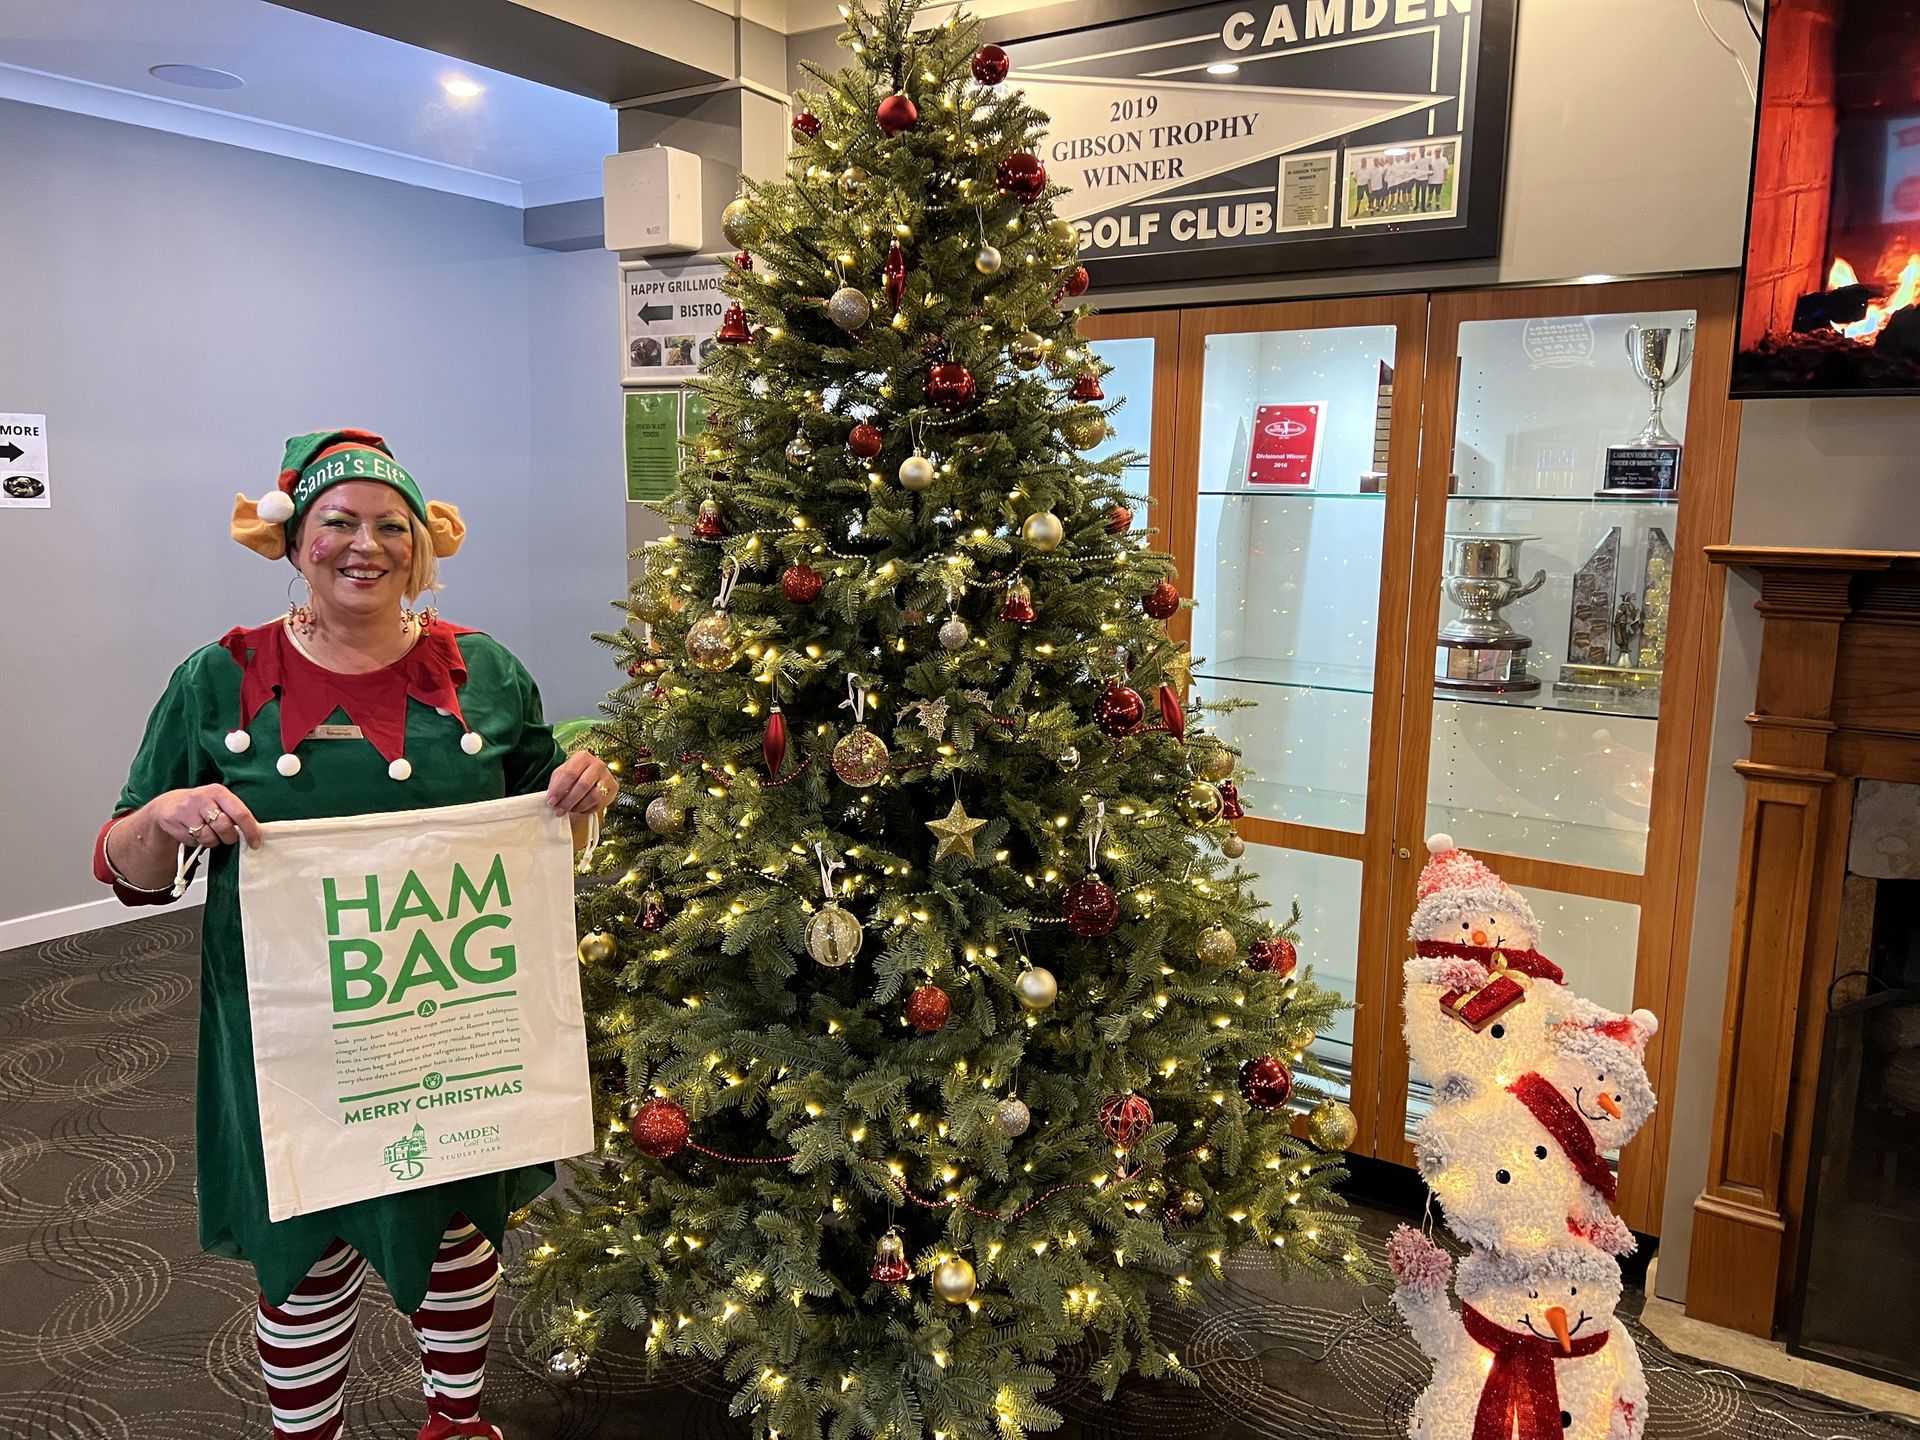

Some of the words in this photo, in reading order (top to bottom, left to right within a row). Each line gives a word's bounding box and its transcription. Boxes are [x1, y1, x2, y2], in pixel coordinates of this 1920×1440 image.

[1110, 95, 1158, 123] 2019
[1052, 130, 1143, 162] GIBSON
[1149, 113, 1259, 149] TROPHY
[1083, 157, 1185, 189] WINNER
[1076, 212, 1161, 251] GOLF
[1170, 202, 1273, 242] CLUB
[631, 282, 665, 296] HAPPY
[680, 303, 722, 318] BISTRO
[0, 425, 39, 436] MORE
[322, 853, 512, 935] HAM
[328, 913, 517, 1012] BAG
[487, 1007, 518, 1015] tablespoon
[388, 1038, 412, 1046] minutes
[429, 1029, 452, 1037] squeeze
[363, 1053, 391, 1061] wrapping
[398, 1067, 418, 1075] ensure
[419, 1063, 432, 1071] your
[454, 1055, 474, 1063] always
[475, 1051, 490, 1059] fresh
[344, 1099, 411, 1125] MERRY
[416, 1079, 522, 1110] CHRISTMAS
[439, 1125, 500, 1144] CAMDEN
[464, 1139, 480, 1148] Golf
[483, 1136, 501, 1144] Club
[441, 1150, 477, 1161] STUDLEY
[481, 1146, 502, 1154] PARK
